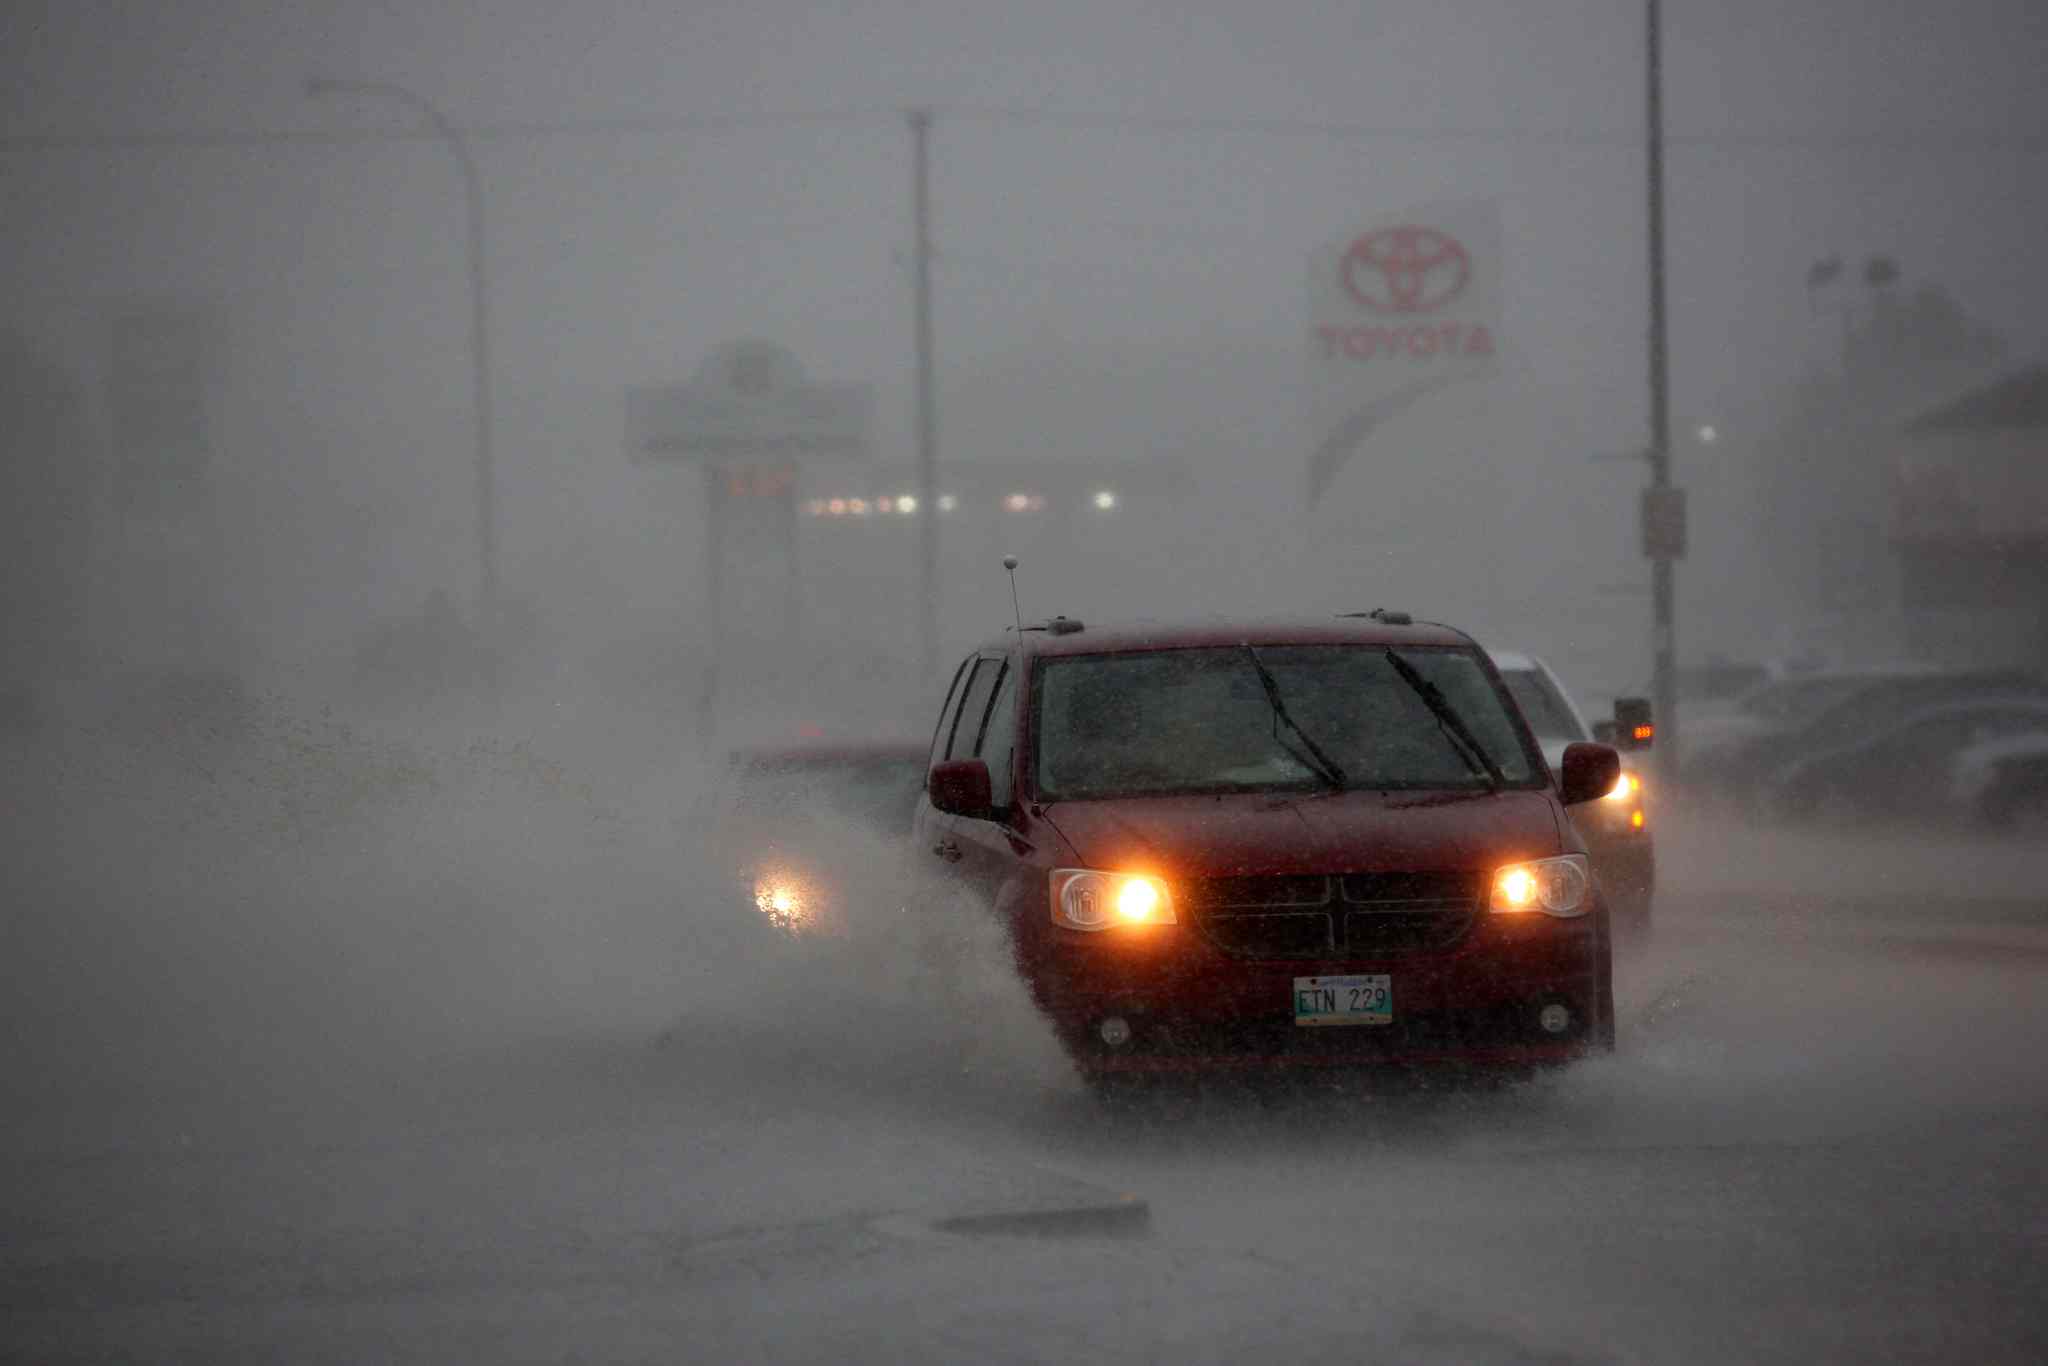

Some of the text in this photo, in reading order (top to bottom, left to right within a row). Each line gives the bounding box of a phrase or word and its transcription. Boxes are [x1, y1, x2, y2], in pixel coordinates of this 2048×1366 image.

[1317, 324, 1494, 358] TOYOTA
[1299, 988, 1386, 1013] ETN 229
